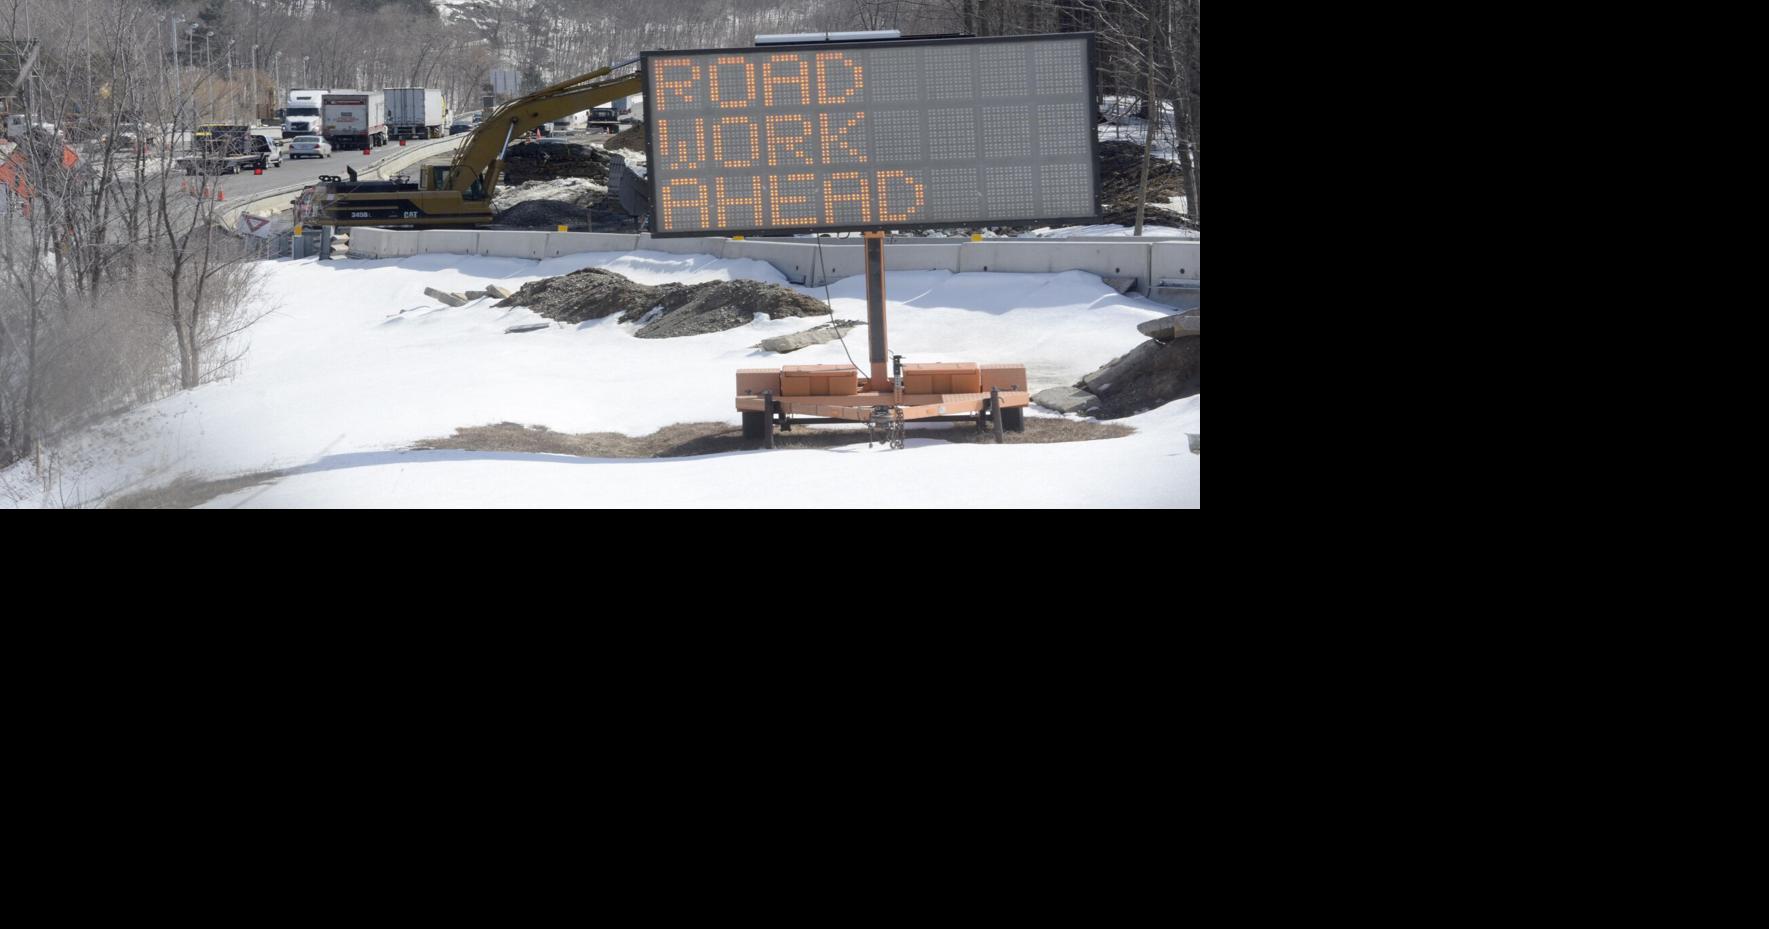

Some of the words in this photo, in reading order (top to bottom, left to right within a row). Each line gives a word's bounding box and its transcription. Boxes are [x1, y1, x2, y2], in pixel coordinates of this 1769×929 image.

[655, 53, 864, 110] ROAD
[659, 112, 867, 169] WORK
[403, 211, 417, 219] CAT
[662, 171, 924, 229] AHEAD
